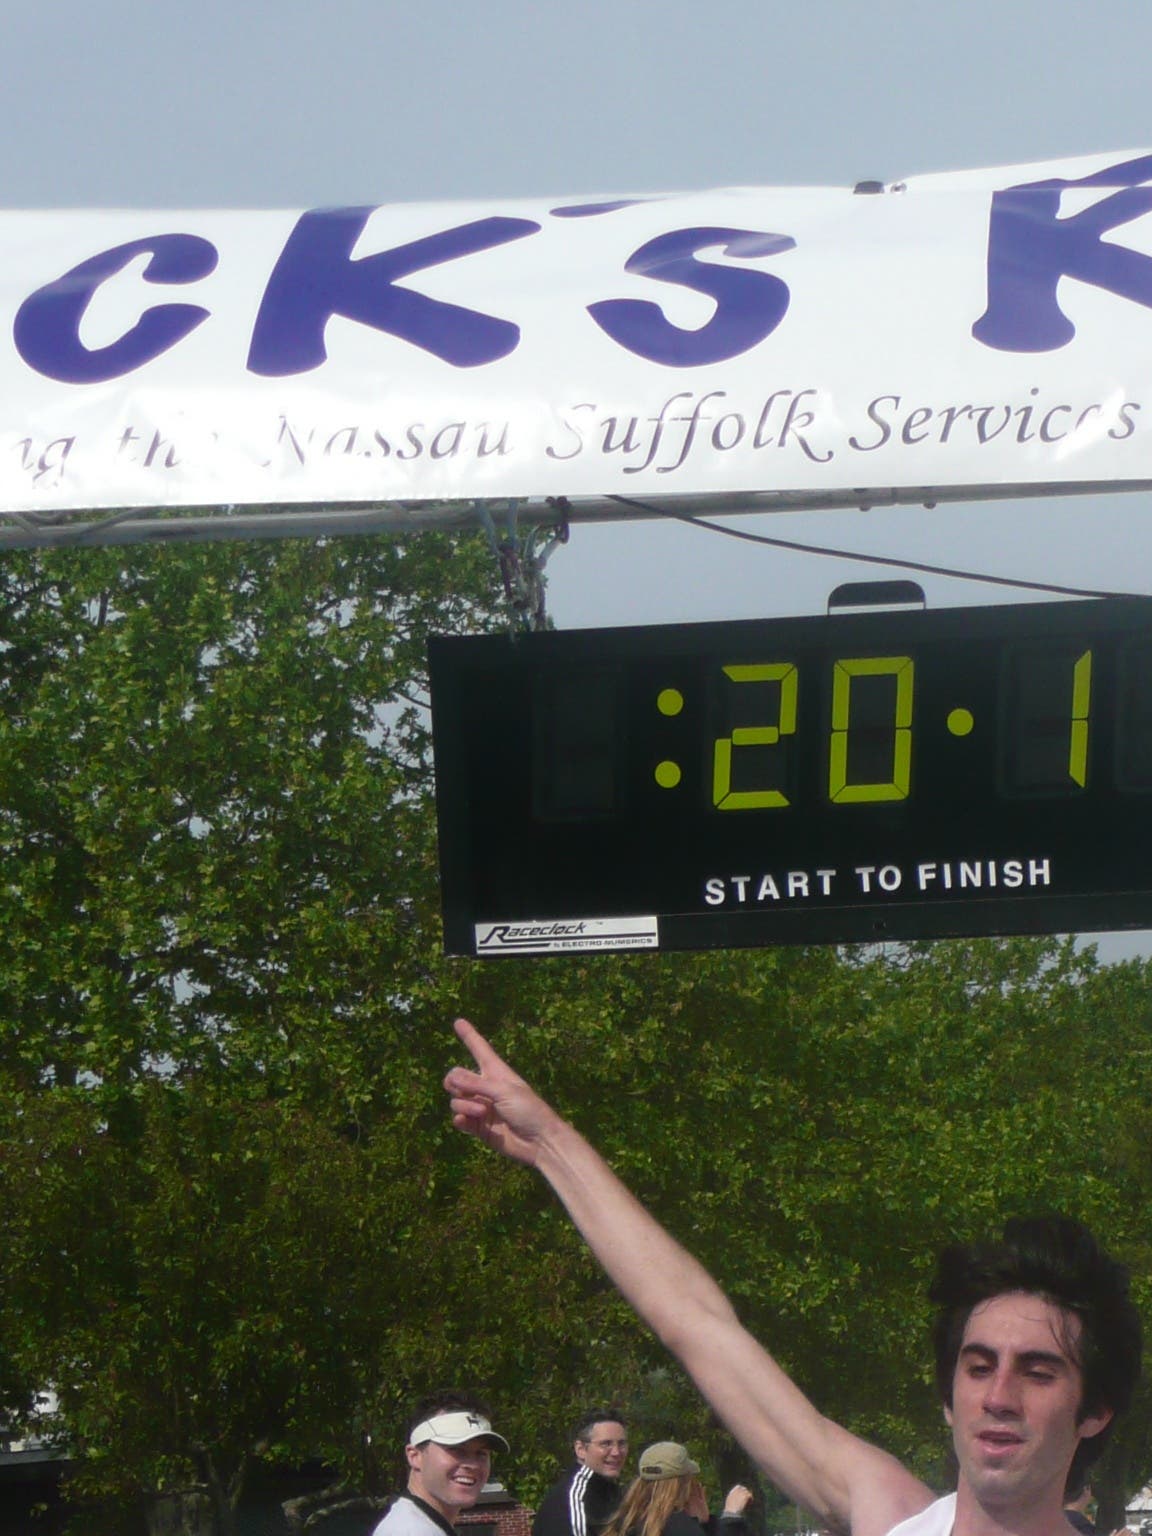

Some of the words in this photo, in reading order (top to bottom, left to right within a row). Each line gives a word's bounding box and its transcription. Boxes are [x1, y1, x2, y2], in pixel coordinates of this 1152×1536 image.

[262, 412, 513, 468] Nassau
[545, 388, 834, 474] Suffolk
[704, 869, 837, 906] START
[854, 864, 902, 893] TO
[918, 858, 1051, 890] FINISH
[479, 921, 587, 945] Raceclock
